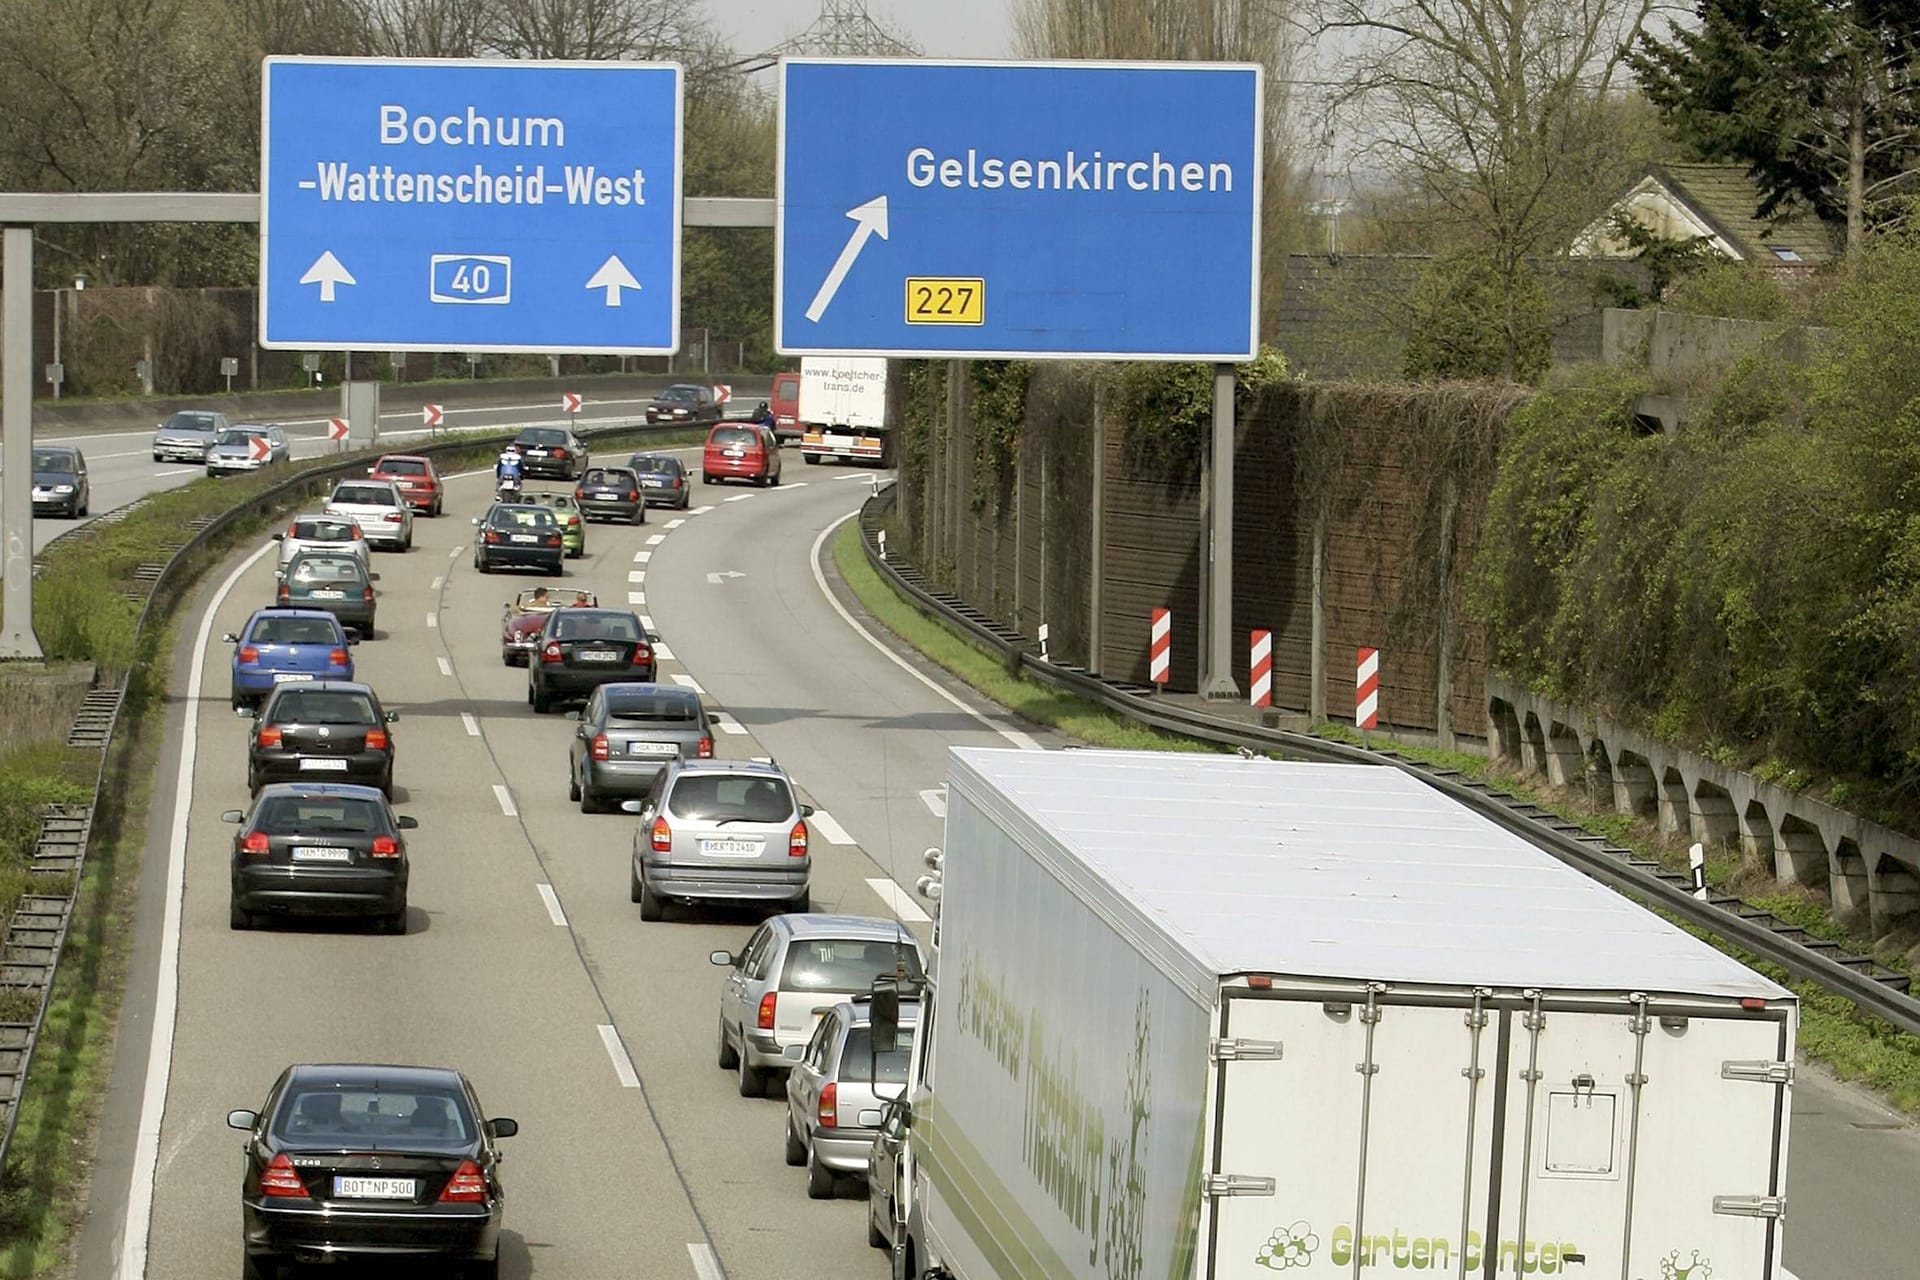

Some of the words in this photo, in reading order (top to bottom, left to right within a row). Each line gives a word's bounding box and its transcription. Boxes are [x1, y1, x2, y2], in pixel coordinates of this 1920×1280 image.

[380, 105, 564, 146] Bochum
[299, 162, 646, 206] -Wattenscheid-West
[907, 148, 1232, 192] Gelsenkirchen
[452, 265, 490, 292] 40
[917, 287, 974, 314] 227
[344, 1181, 366, 1192] BOT
[374, 1183, 390, 1193] NP
[392, 1183, 413, 1194] 500
